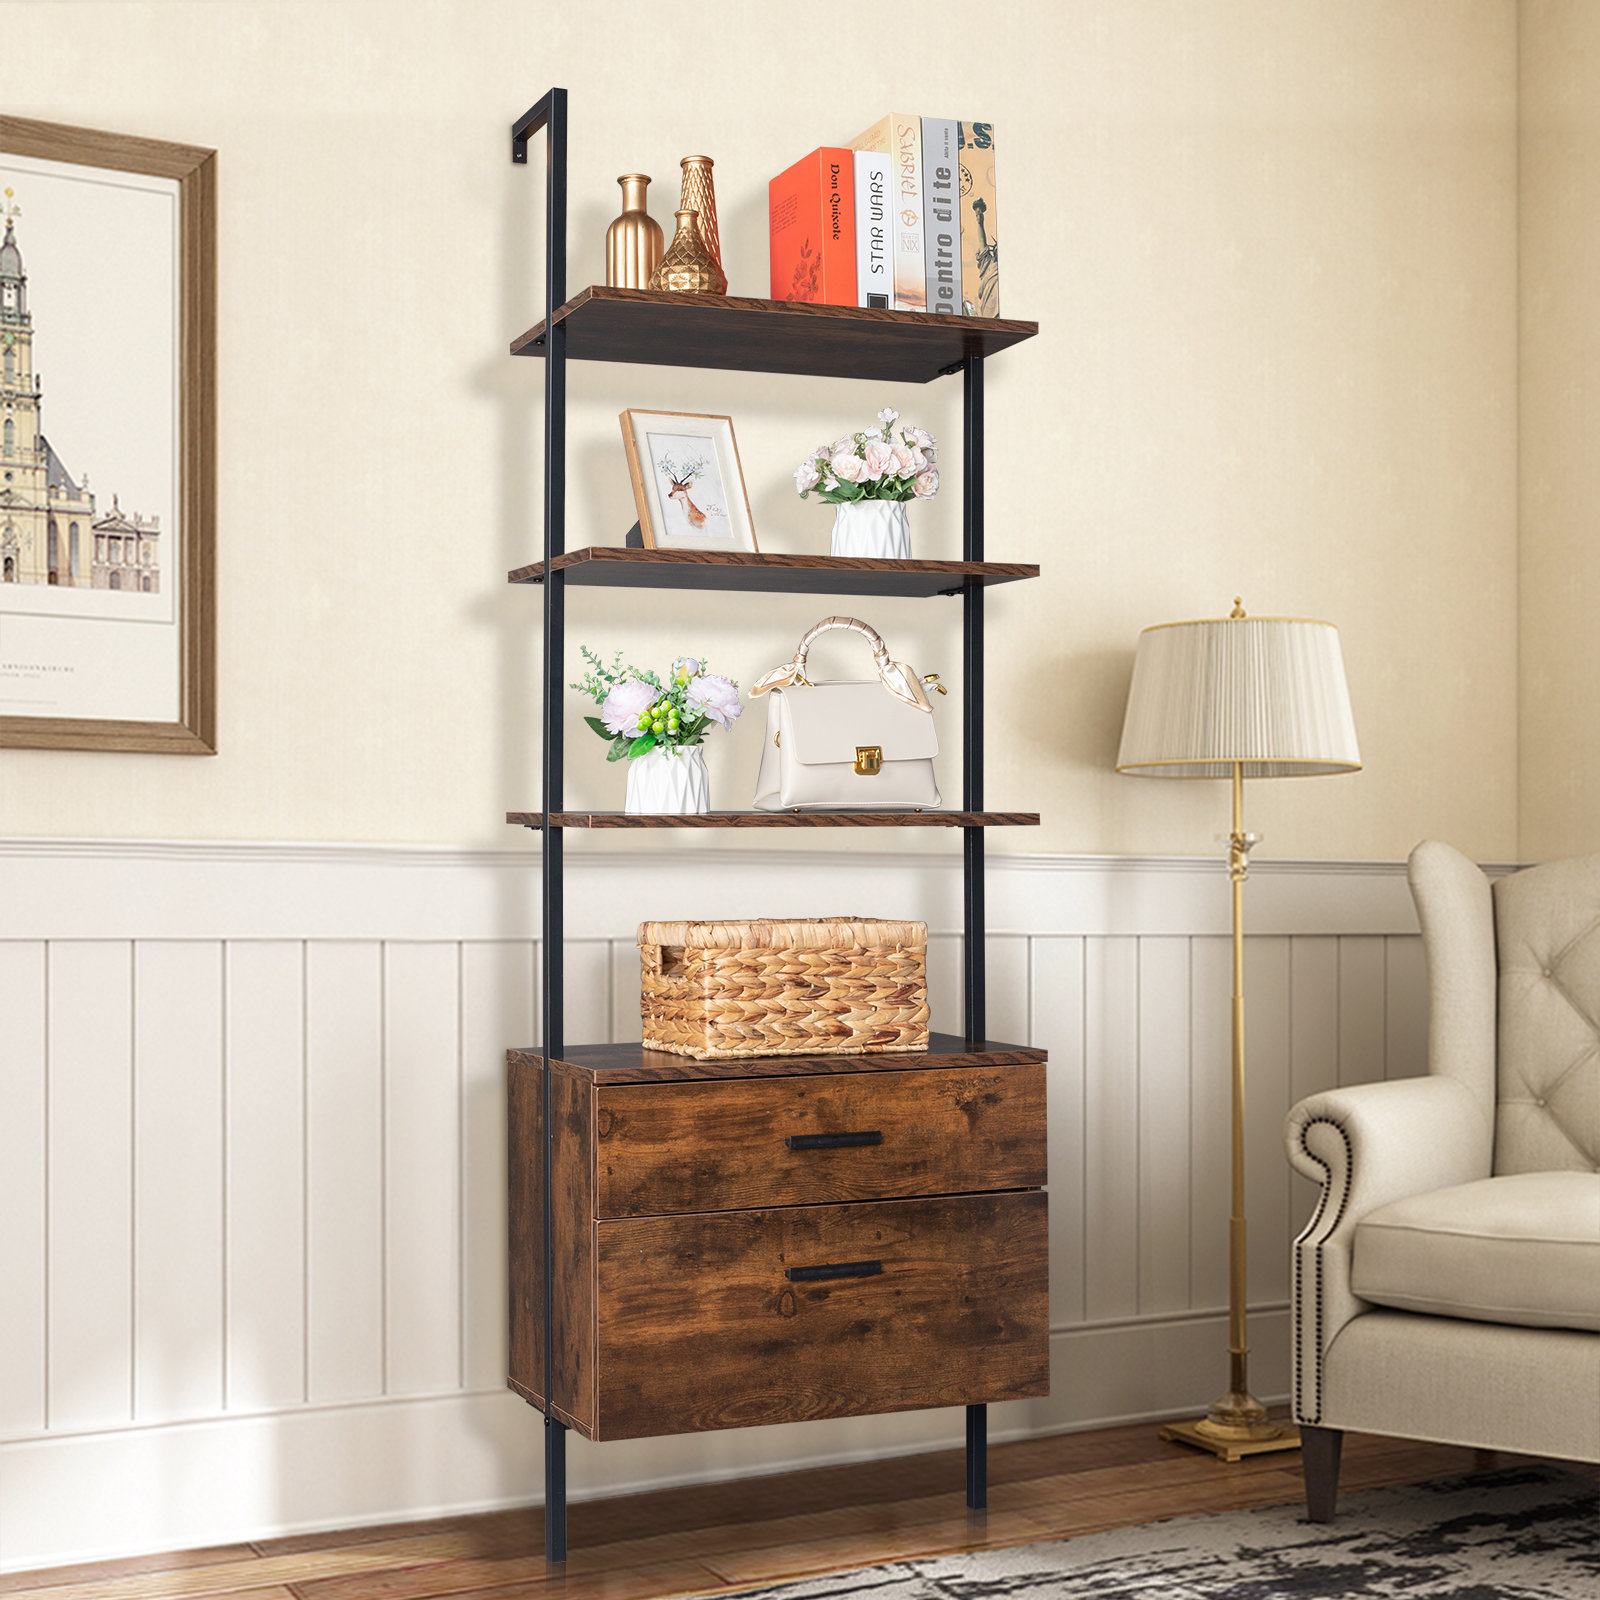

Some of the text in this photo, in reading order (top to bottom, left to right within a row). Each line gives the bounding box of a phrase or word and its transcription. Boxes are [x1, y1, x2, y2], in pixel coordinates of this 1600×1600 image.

[830, 163, 840, 190] Don
[897, 124, 918, 204] SABRIEL
[932, 167, 951, 189] te
[870, 170, 884, 274] STAR WARS
[934, 233, 953, 314] Dentro
